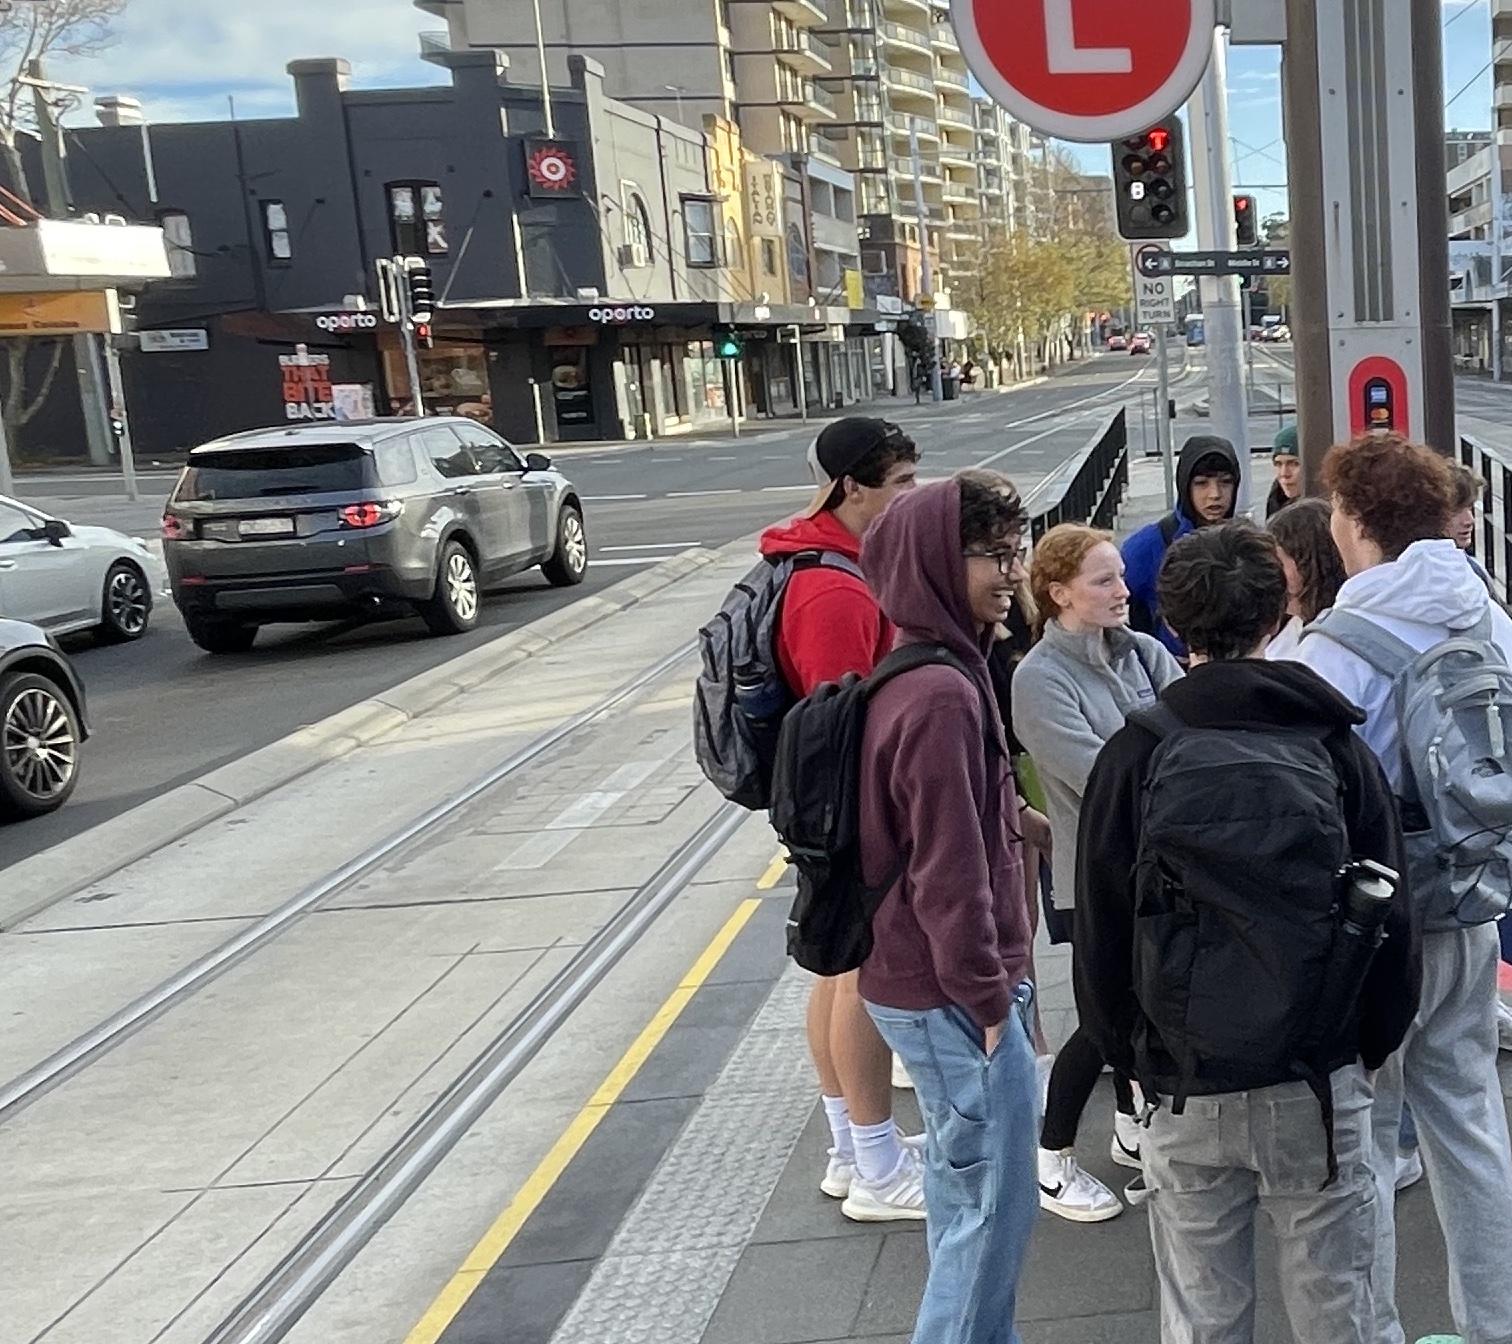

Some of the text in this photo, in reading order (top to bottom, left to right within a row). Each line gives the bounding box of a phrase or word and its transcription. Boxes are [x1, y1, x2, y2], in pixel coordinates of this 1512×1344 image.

[1143, 282, 1165, 295] NO
[1139, 297, 1169, 308] RIGHT
[316, 313, 377, 332] oporto
[588, 306, 654, 323] oporto
[1142, 310, 1171, 319] TURN
[281, 366, 330, 382] THAT
[284, 381, 333, 402] BITE
[286, 402, 336, 419] BACK
